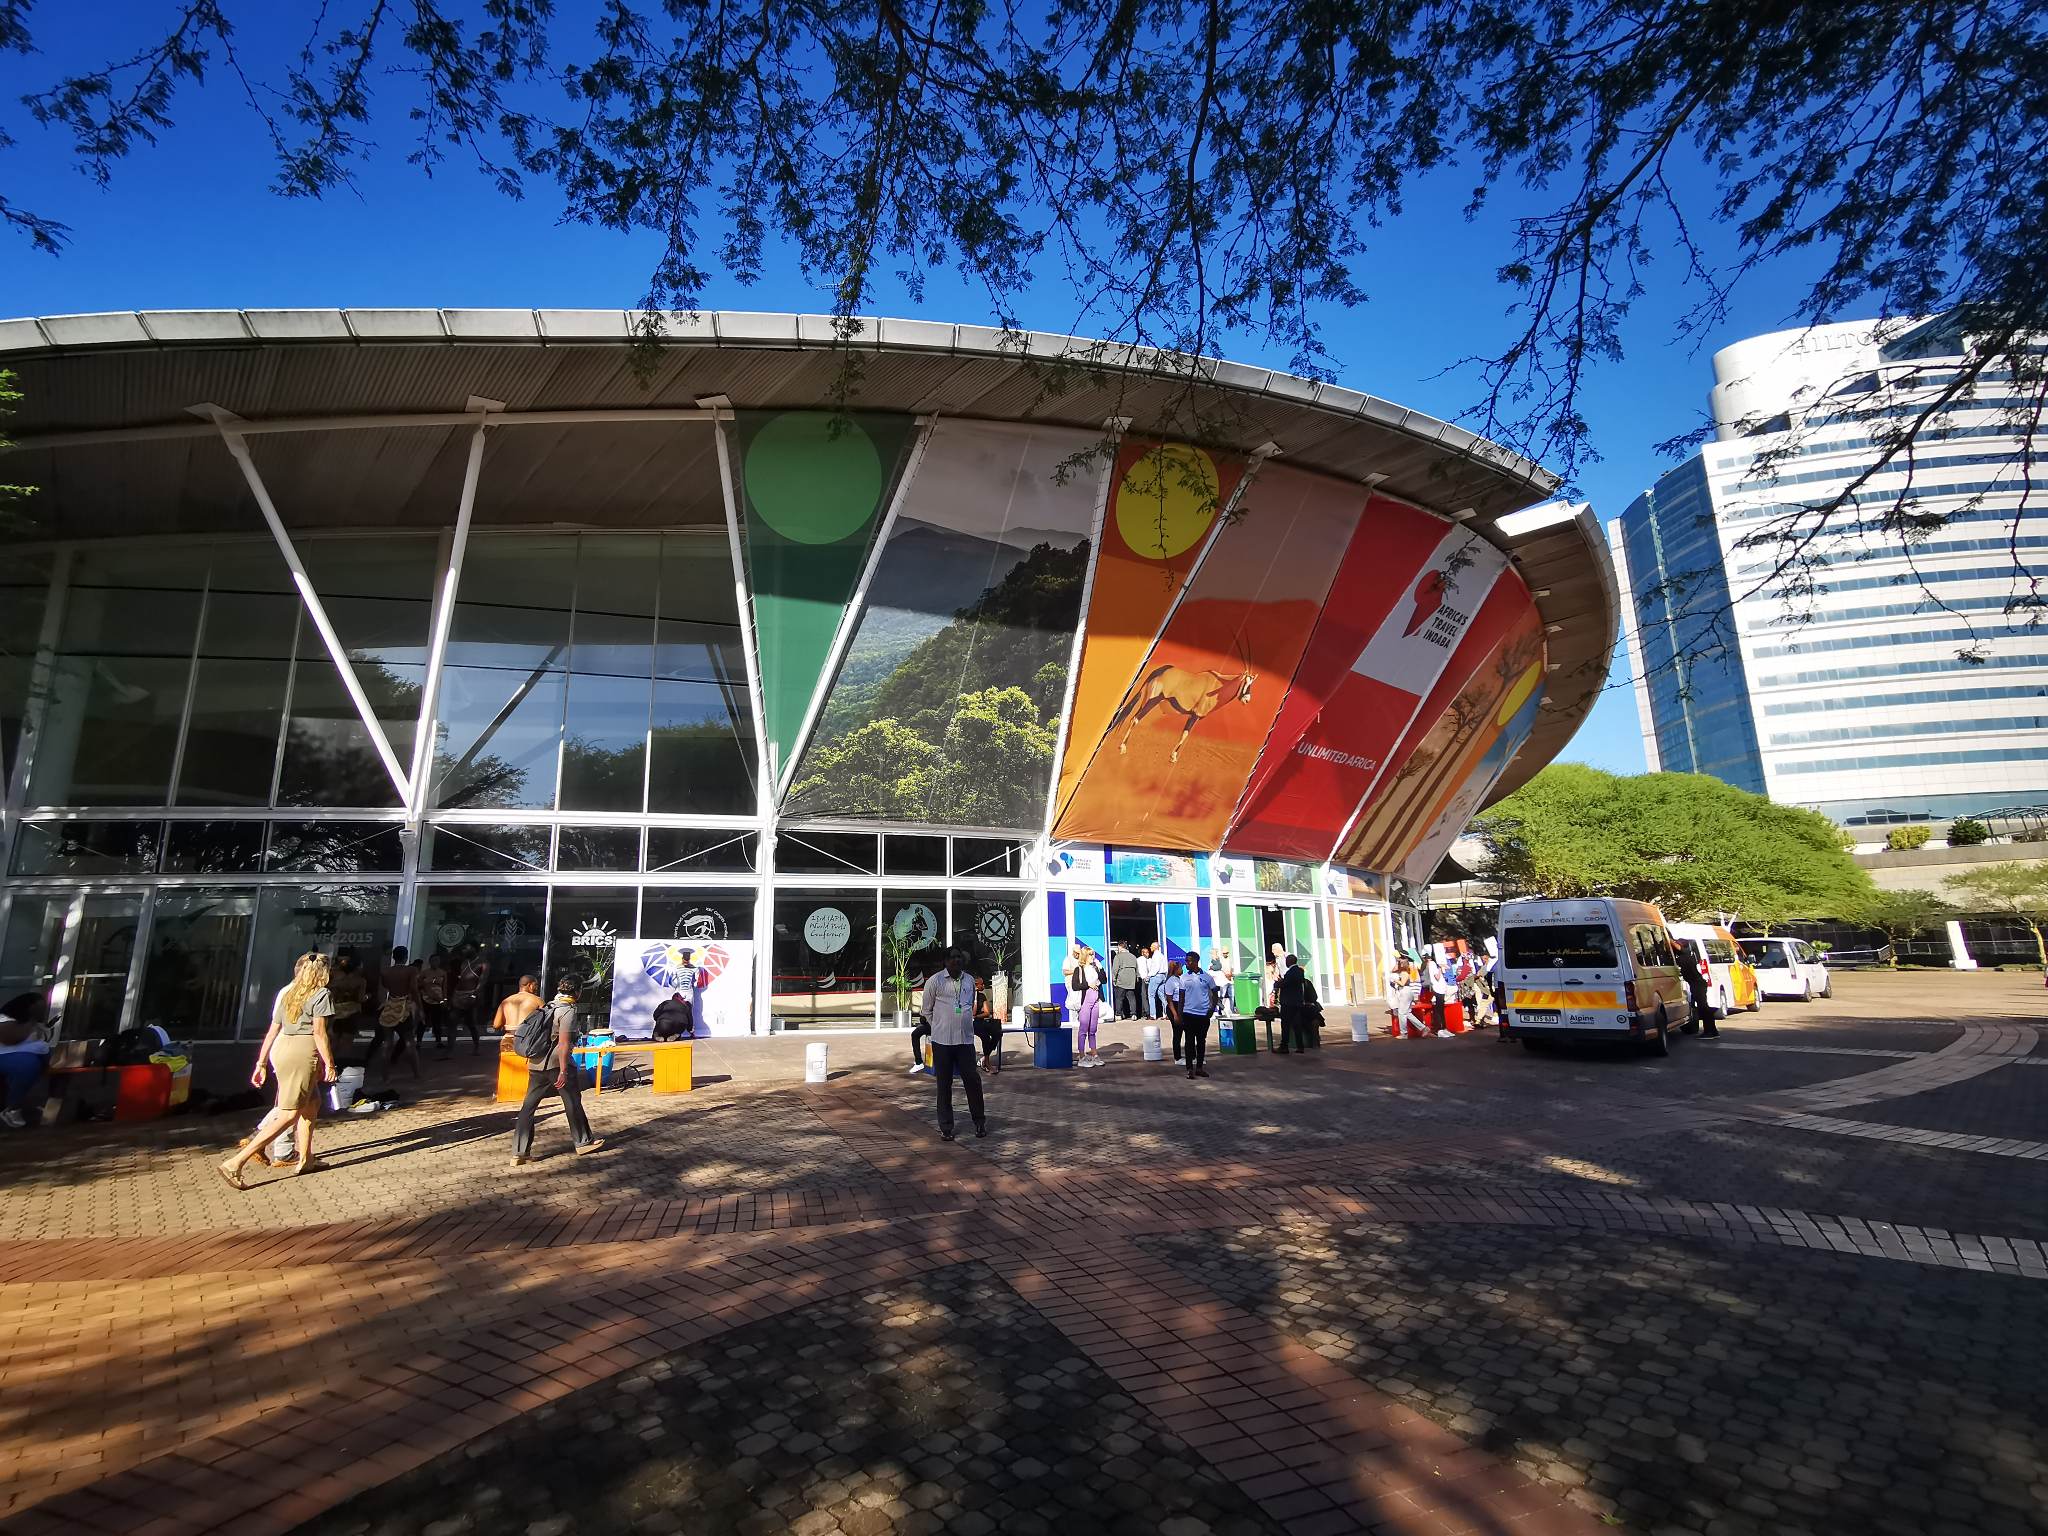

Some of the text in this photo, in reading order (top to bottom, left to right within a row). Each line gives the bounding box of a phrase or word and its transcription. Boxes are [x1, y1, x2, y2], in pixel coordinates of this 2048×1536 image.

[1437, 604, 1468, 626] AFRICA'S
[1431, 617, 1459, 637] TRAVEL
[1423, 629, 1451, 649] INDABA
[1297, 742, 1377, 770] UNLIMITED AFRICA
[571, 935, 613, 946] BRICS
[1569, 1014, 1594, 1023] Alpine
